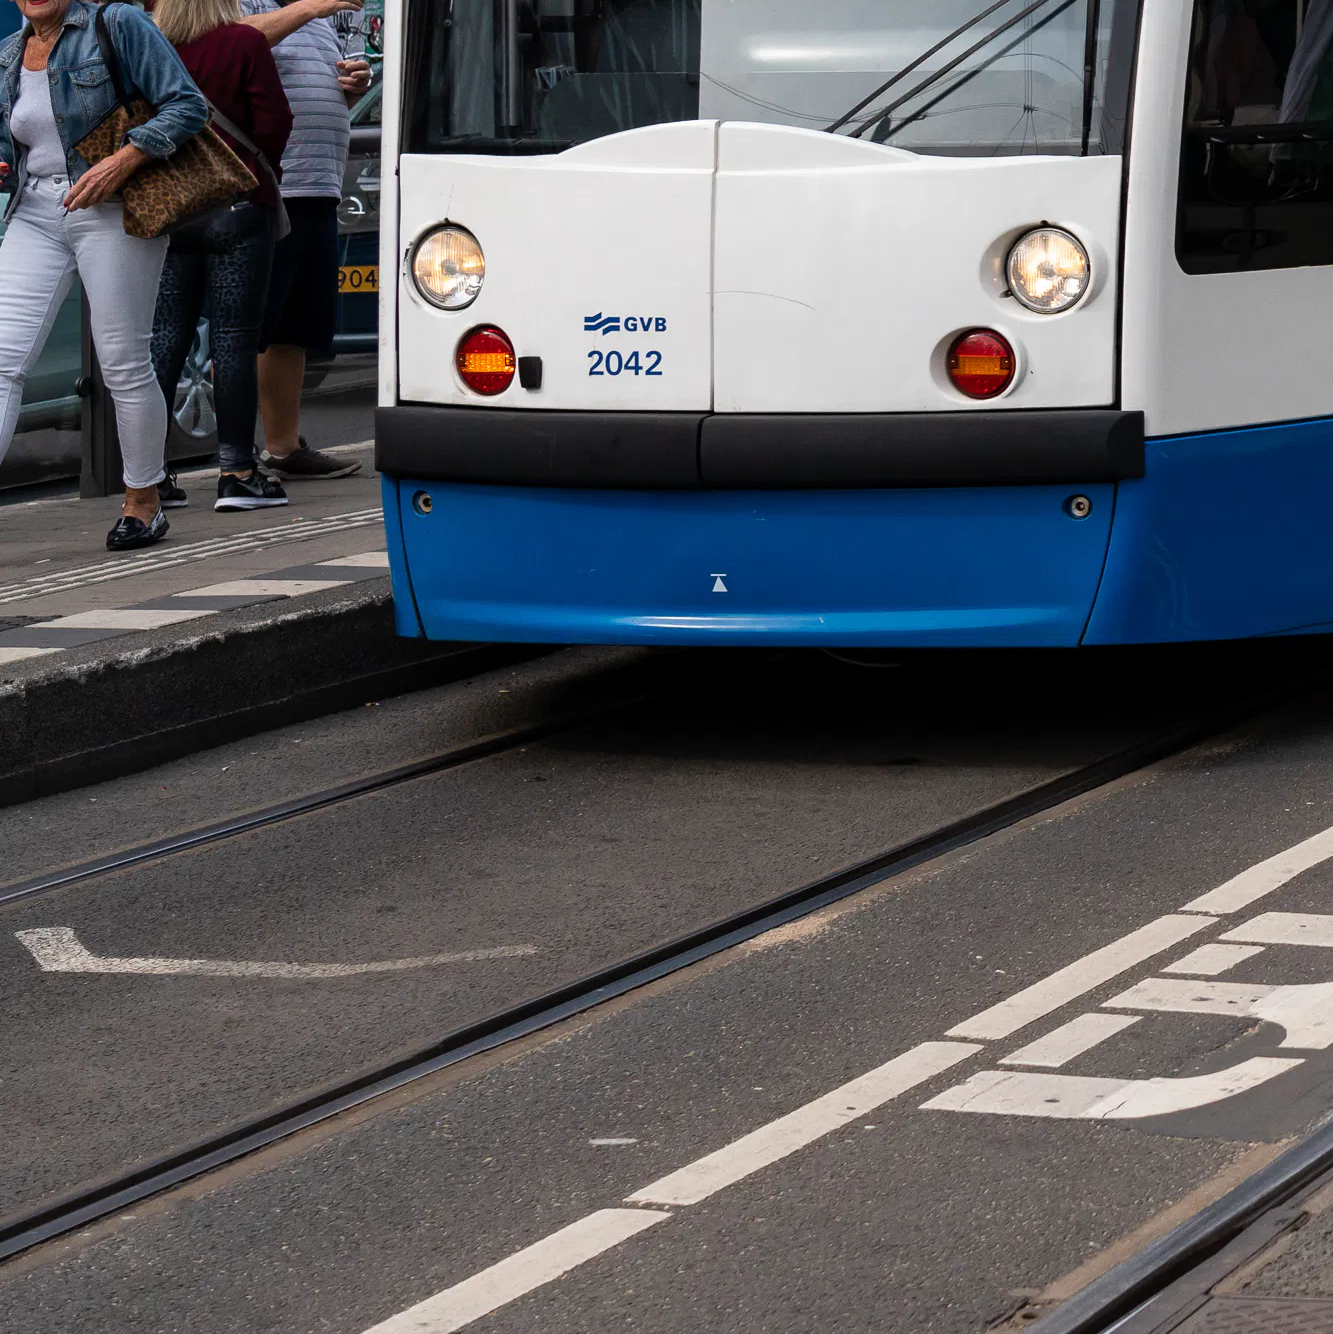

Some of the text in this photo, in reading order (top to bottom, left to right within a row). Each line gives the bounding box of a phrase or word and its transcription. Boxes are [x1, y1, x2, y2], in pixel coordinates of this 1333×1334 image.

[338, 269, 378, 288] 904
[623, 316, 667, 332] GVB
[587, 350, 663, 376] 2042
